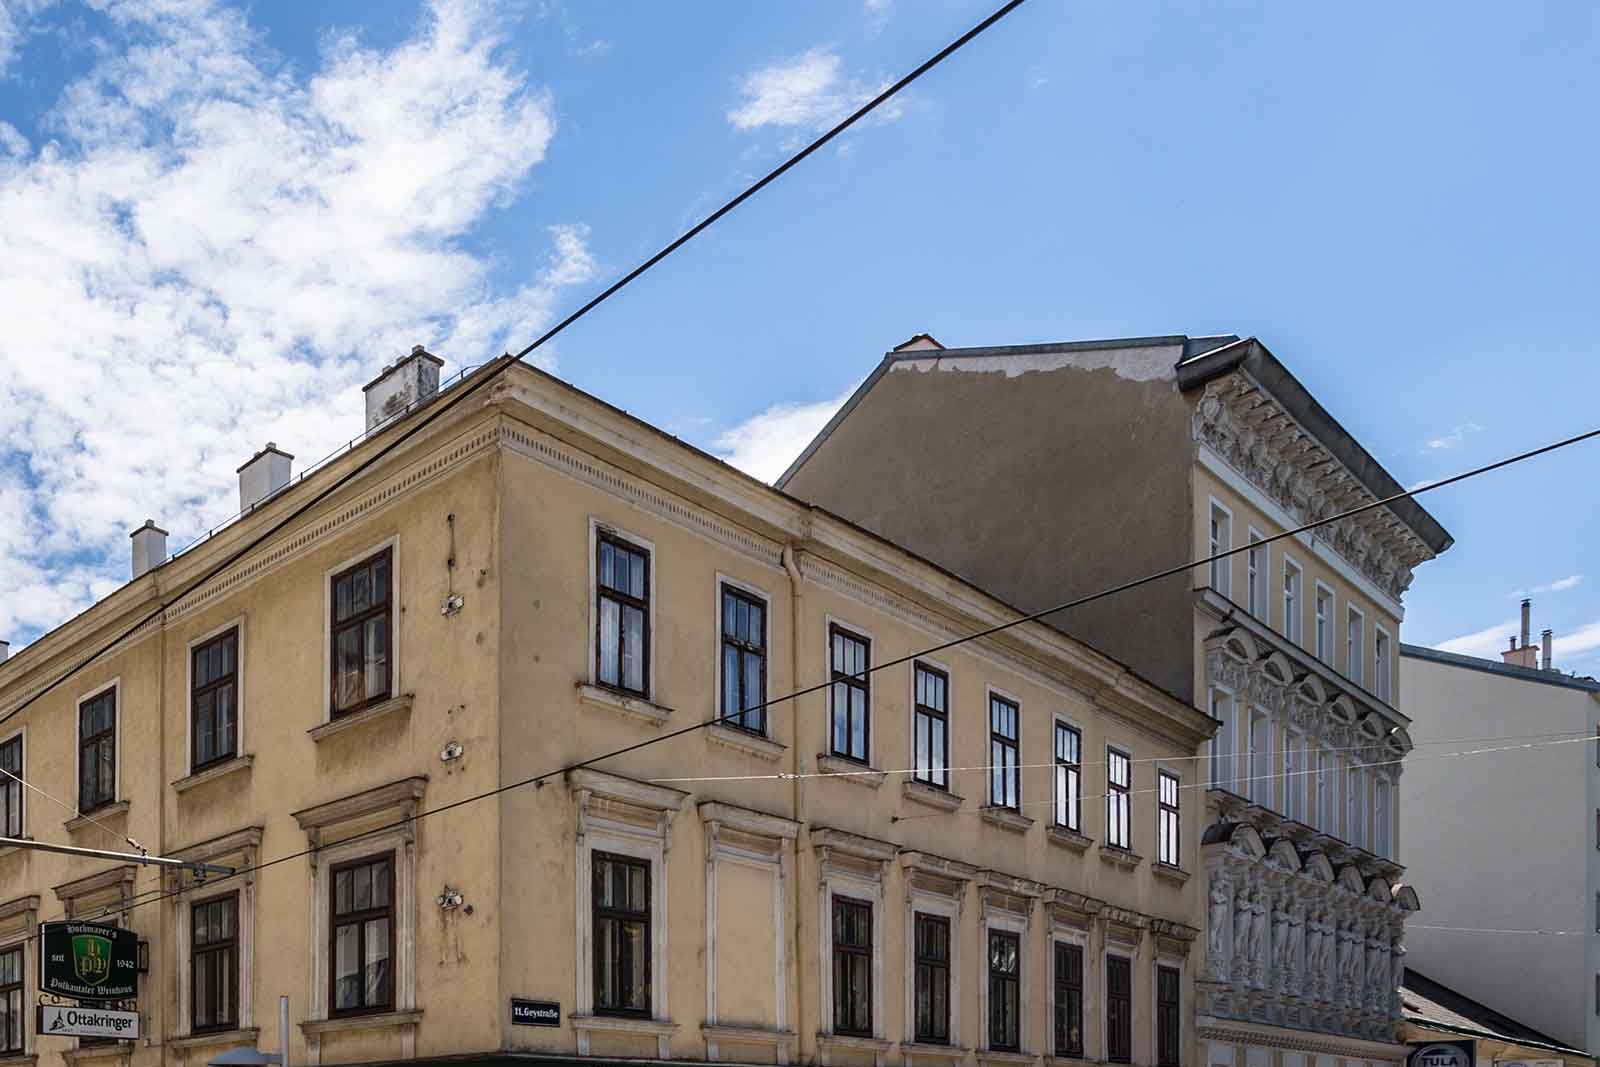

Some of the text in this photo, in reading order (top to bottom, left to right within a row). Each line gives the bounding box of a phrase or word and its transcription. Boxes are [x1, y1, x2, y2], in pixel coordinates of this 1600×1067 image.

[66, 924, 117, 939] Hochmayer's
[117, 959, 134, 969] 1942
[67, 1011, 133, 1031] Ottakringer
